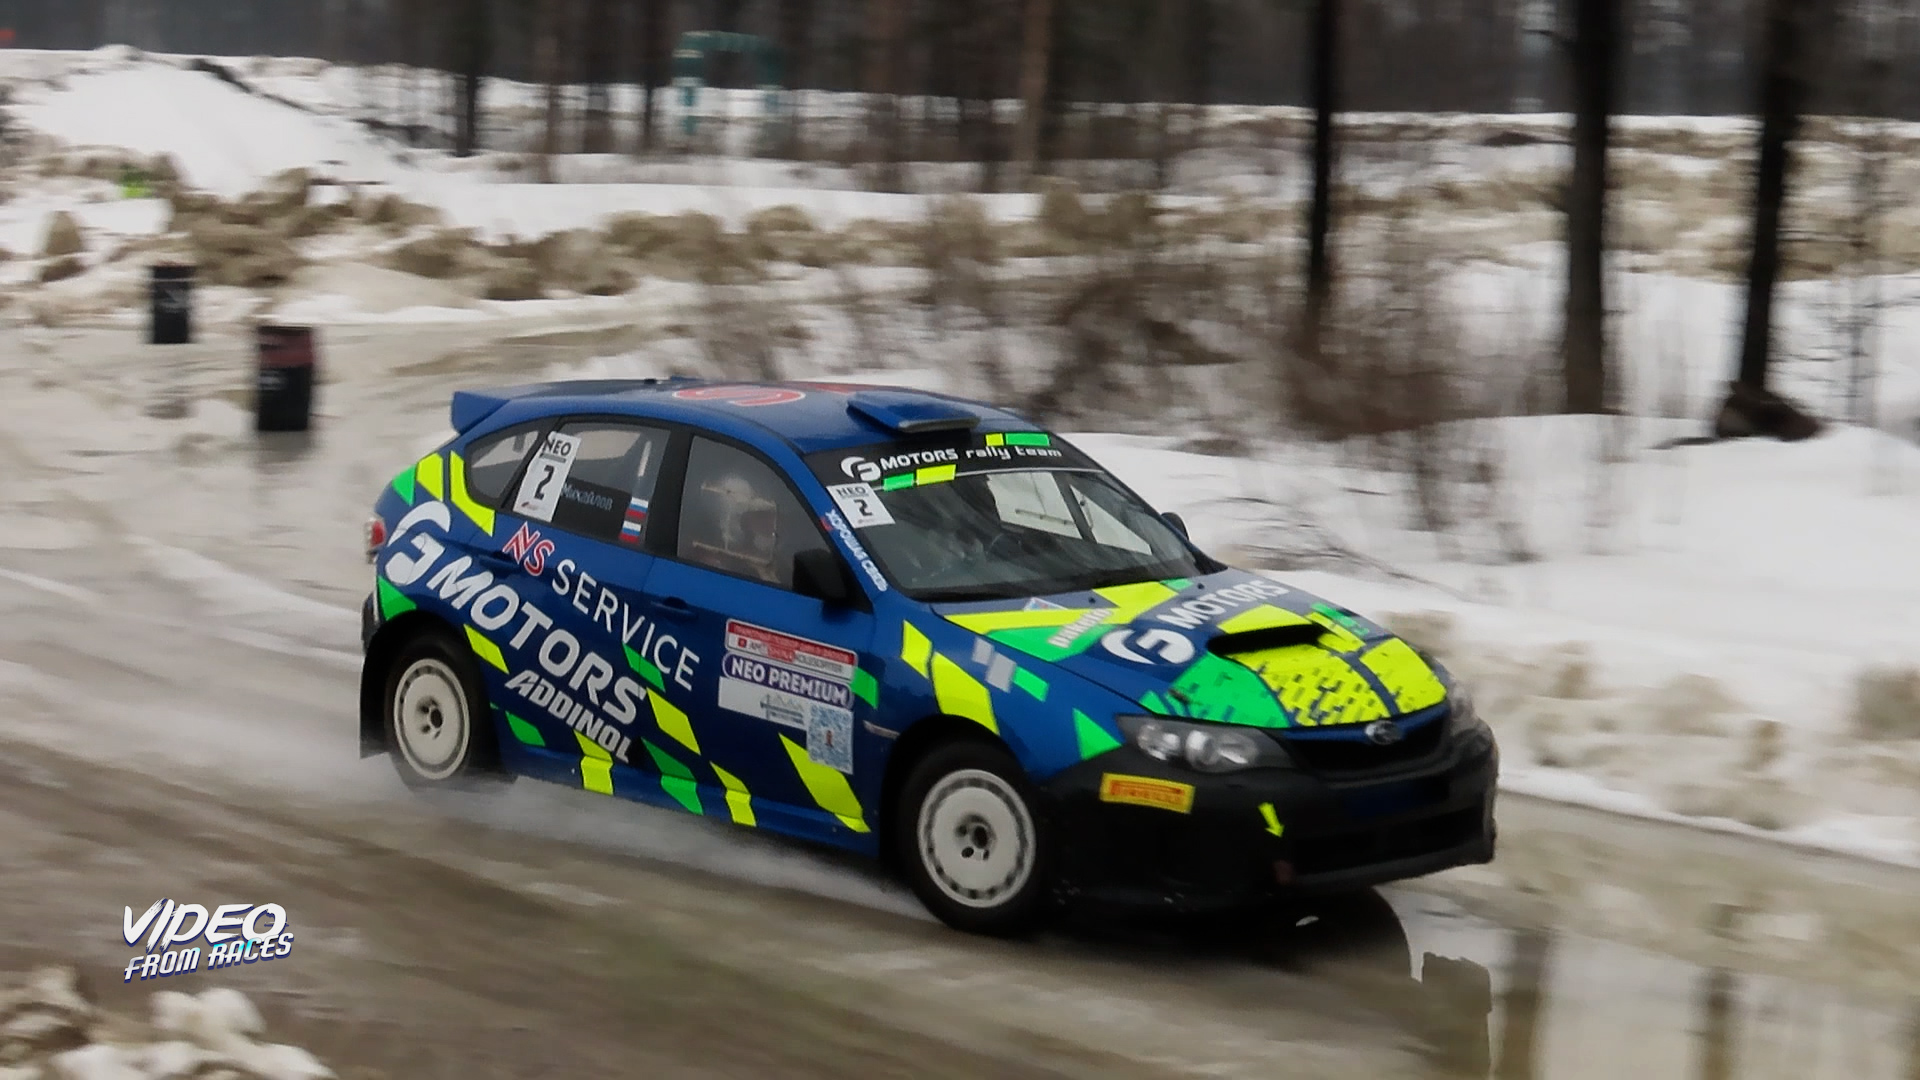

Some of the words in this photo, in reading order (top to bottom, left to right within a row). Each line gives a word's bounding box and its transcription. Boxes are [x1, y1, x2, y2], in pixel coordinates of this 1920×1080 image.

[541, 438, 572, 456] NEO
[880, 448, 959, 471] MOTORS
[966, 446, 1009, 460] rally
[1015, 446, 1062, 458] team
[534, 464, 555, 500] 2
[853, 498, 873, 517] 2
[502, 521, 555, 576] NS
[552, 559, 700, 691] SERVICE
[1155, 579, 1291, 630] MOTORS
[426, 555, 648, 725] MOTORS
[731, 657, 766, 683] NEO
[768, 667, 848, 707] PREMIUM
[505, 669, 634, 763] ADDINOL
